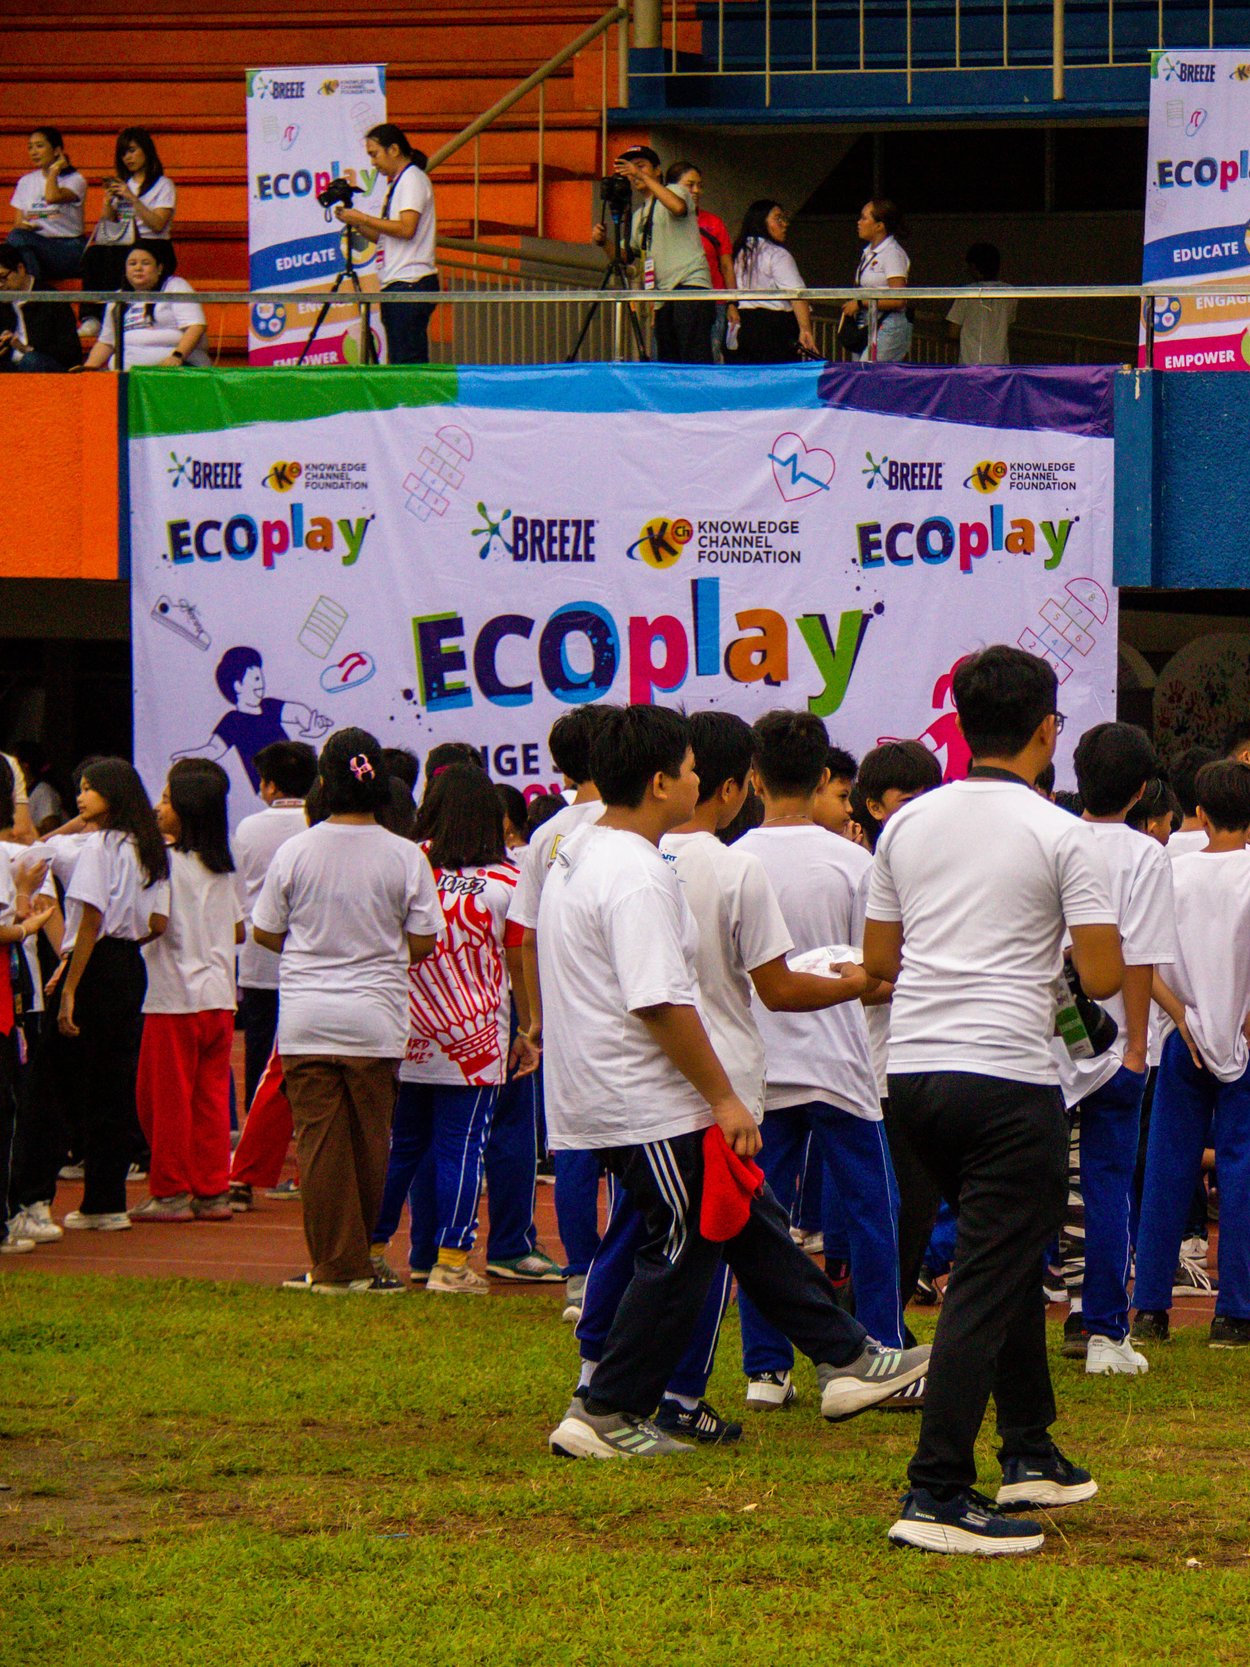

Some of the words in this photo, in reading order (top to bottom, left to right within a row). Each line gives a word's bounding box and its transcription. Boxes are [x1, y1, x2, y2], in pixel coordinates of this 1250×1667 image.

[1179, 63, 1216, 83] BREEZE
[273, 81, 305, 99] BREEZE
[275, 248, 337, 271] EDUCATE
[1173, 241, 1240, 263] EDUCATE
[1164, 349, 1236, 369] EMPOWER
[192, 460, 243, 490] BREEZE
[304, 463, 368, 472] KNOWLEDGE
[304, 472, 351, 481] CHANNEL
[888, 460, 943, 491] BREEZE
[1010, 462, 1076, 472] KNOWLEDGE
[1010, 472, 1058, 481] CHANNEL
[304, 481, 369, 490] FOUNDATION
[1010, 481, 1077, 491] FOUNDATION
[166, 503, 371, 570] ECOplay
[698, 521, 800, 534] KNOWLEDGE
[512, 516, 596, 563] BREEZE
[698, 535, 773, 549] CHANNEL
[856, 504, 1075, 575] ECOplay
[698, 550, 801, 564] FOUNDATION
[412, 576, 871, 718] ECOplay
